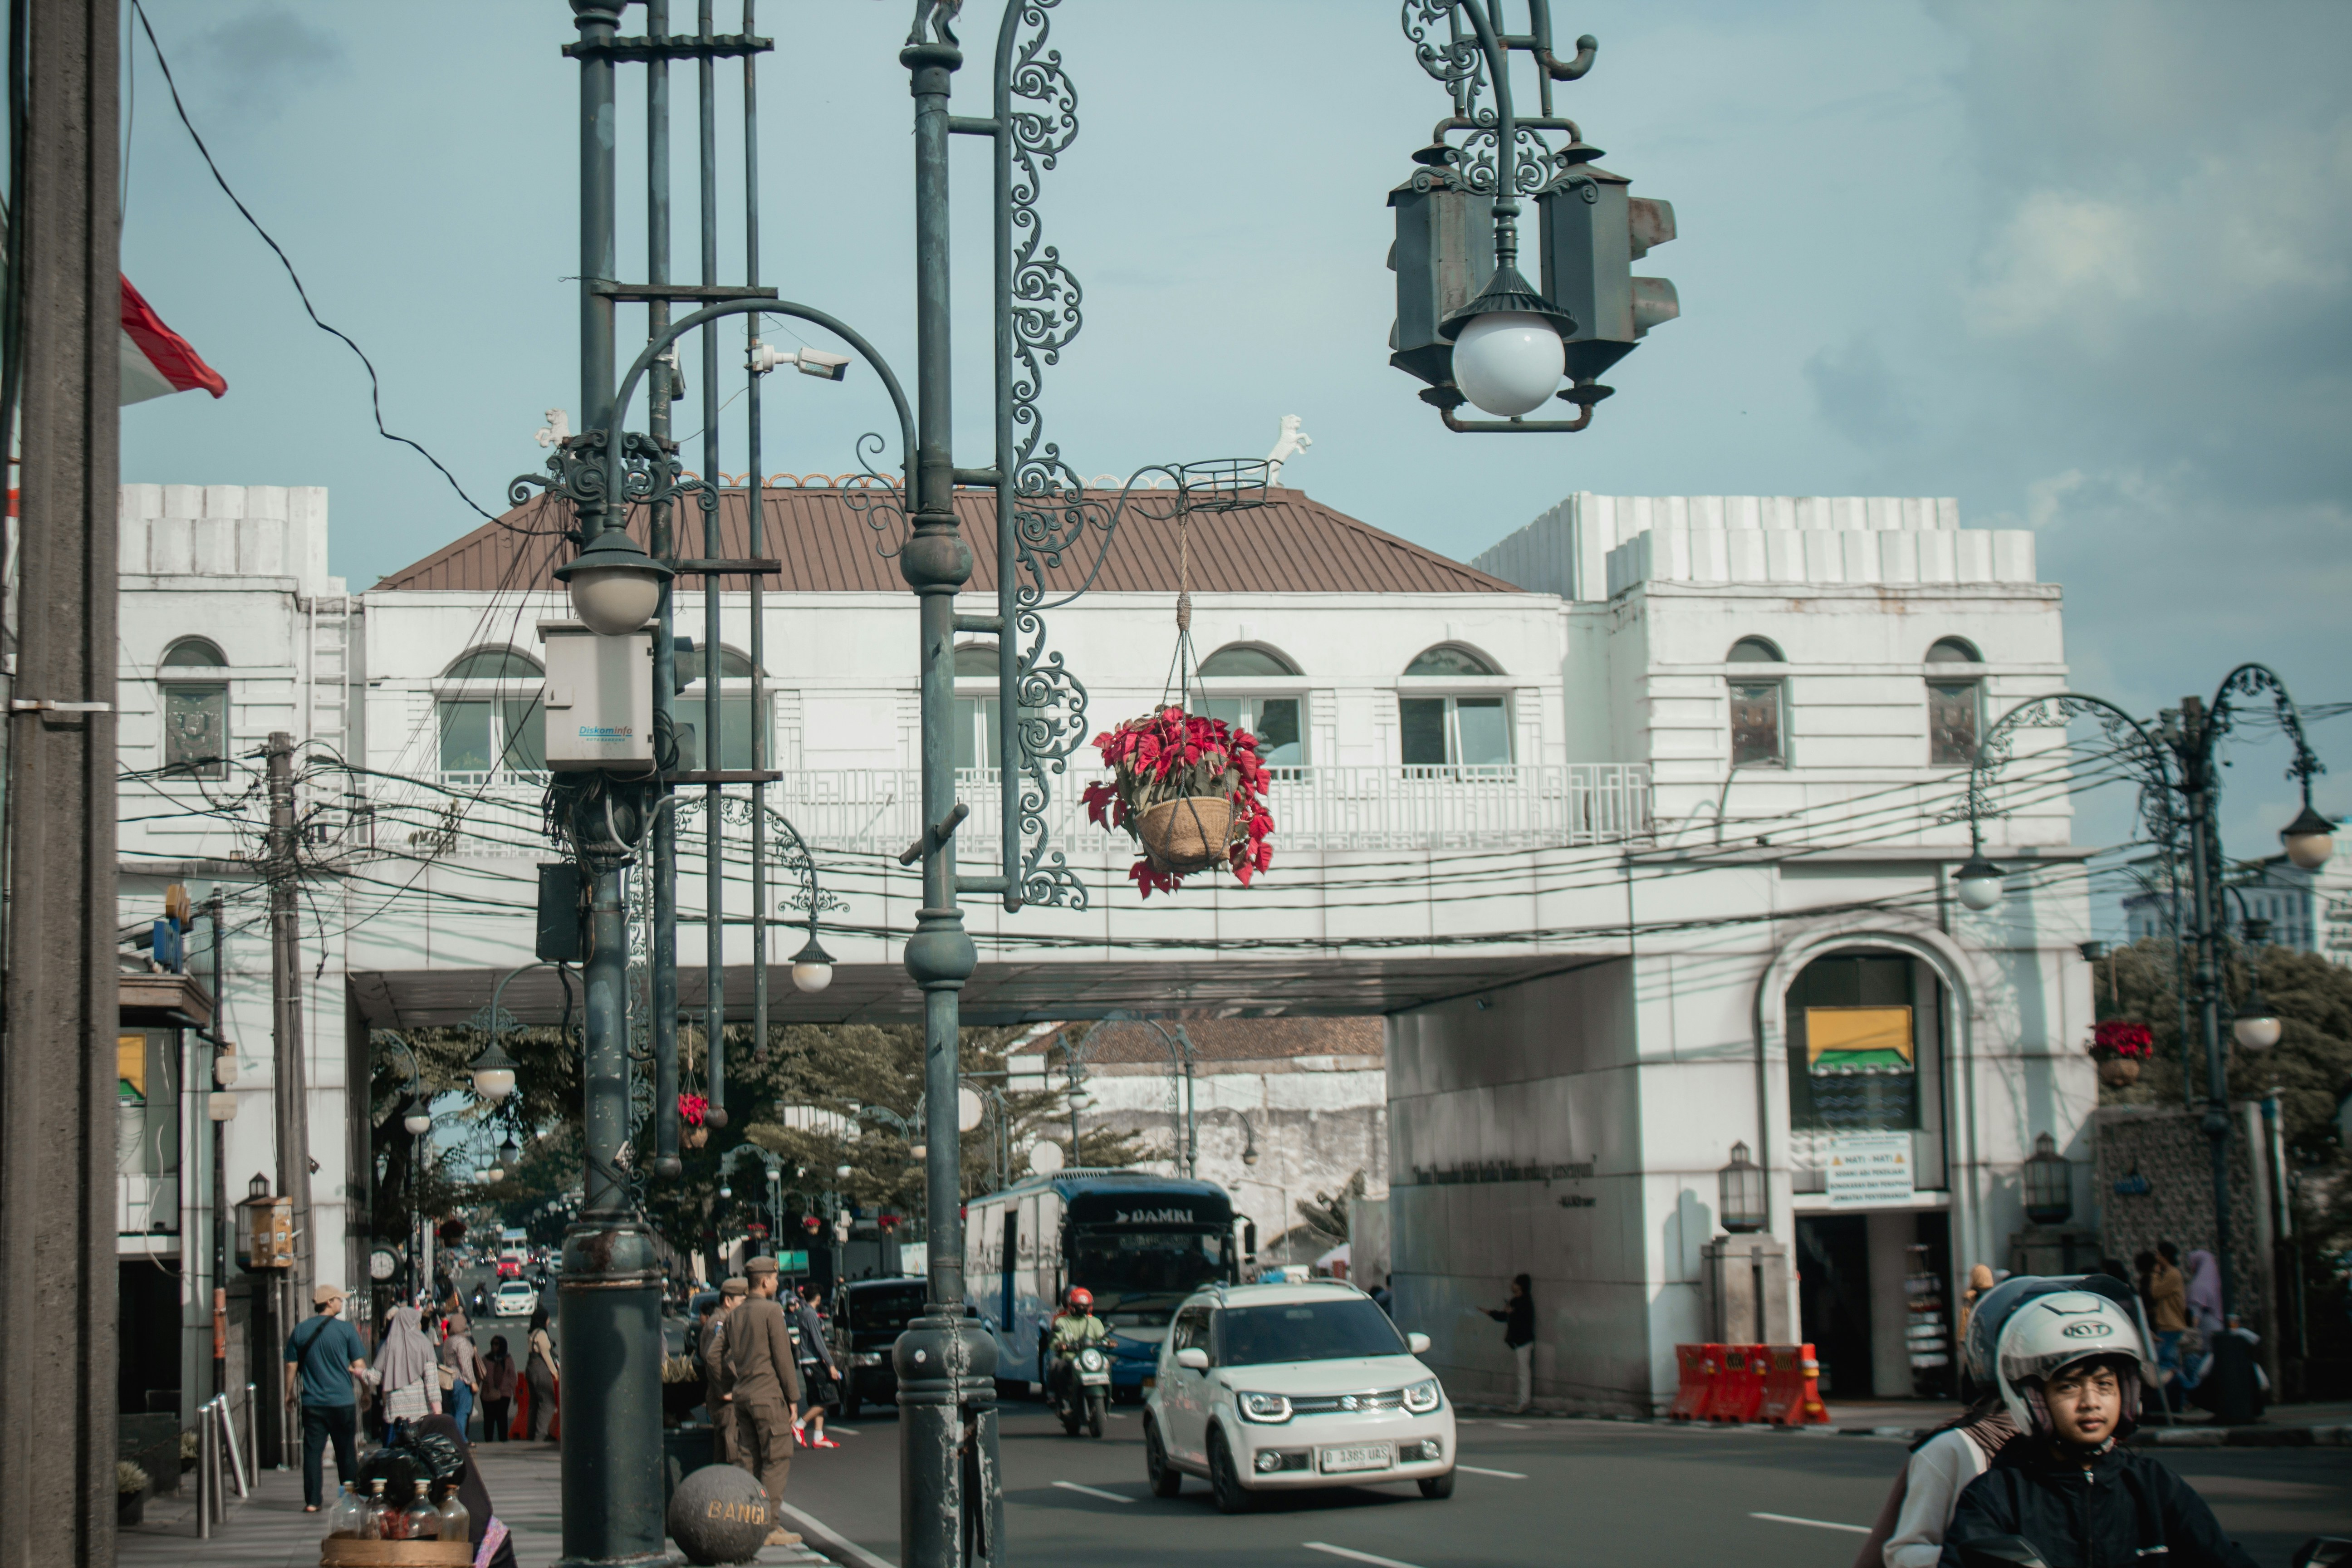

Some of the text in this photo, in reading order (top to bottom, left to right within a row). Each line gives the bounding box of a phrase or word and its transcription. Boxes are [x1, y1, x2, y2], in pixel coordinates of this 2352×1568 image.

[579, 726, 632, 736] Diskominfo
[1132, 1208, 1194, 1223] DAMRI
[1326, 1448, 1387, 1463] D 1385 UAS
[708, 1499, 771, 1525] BANGL
